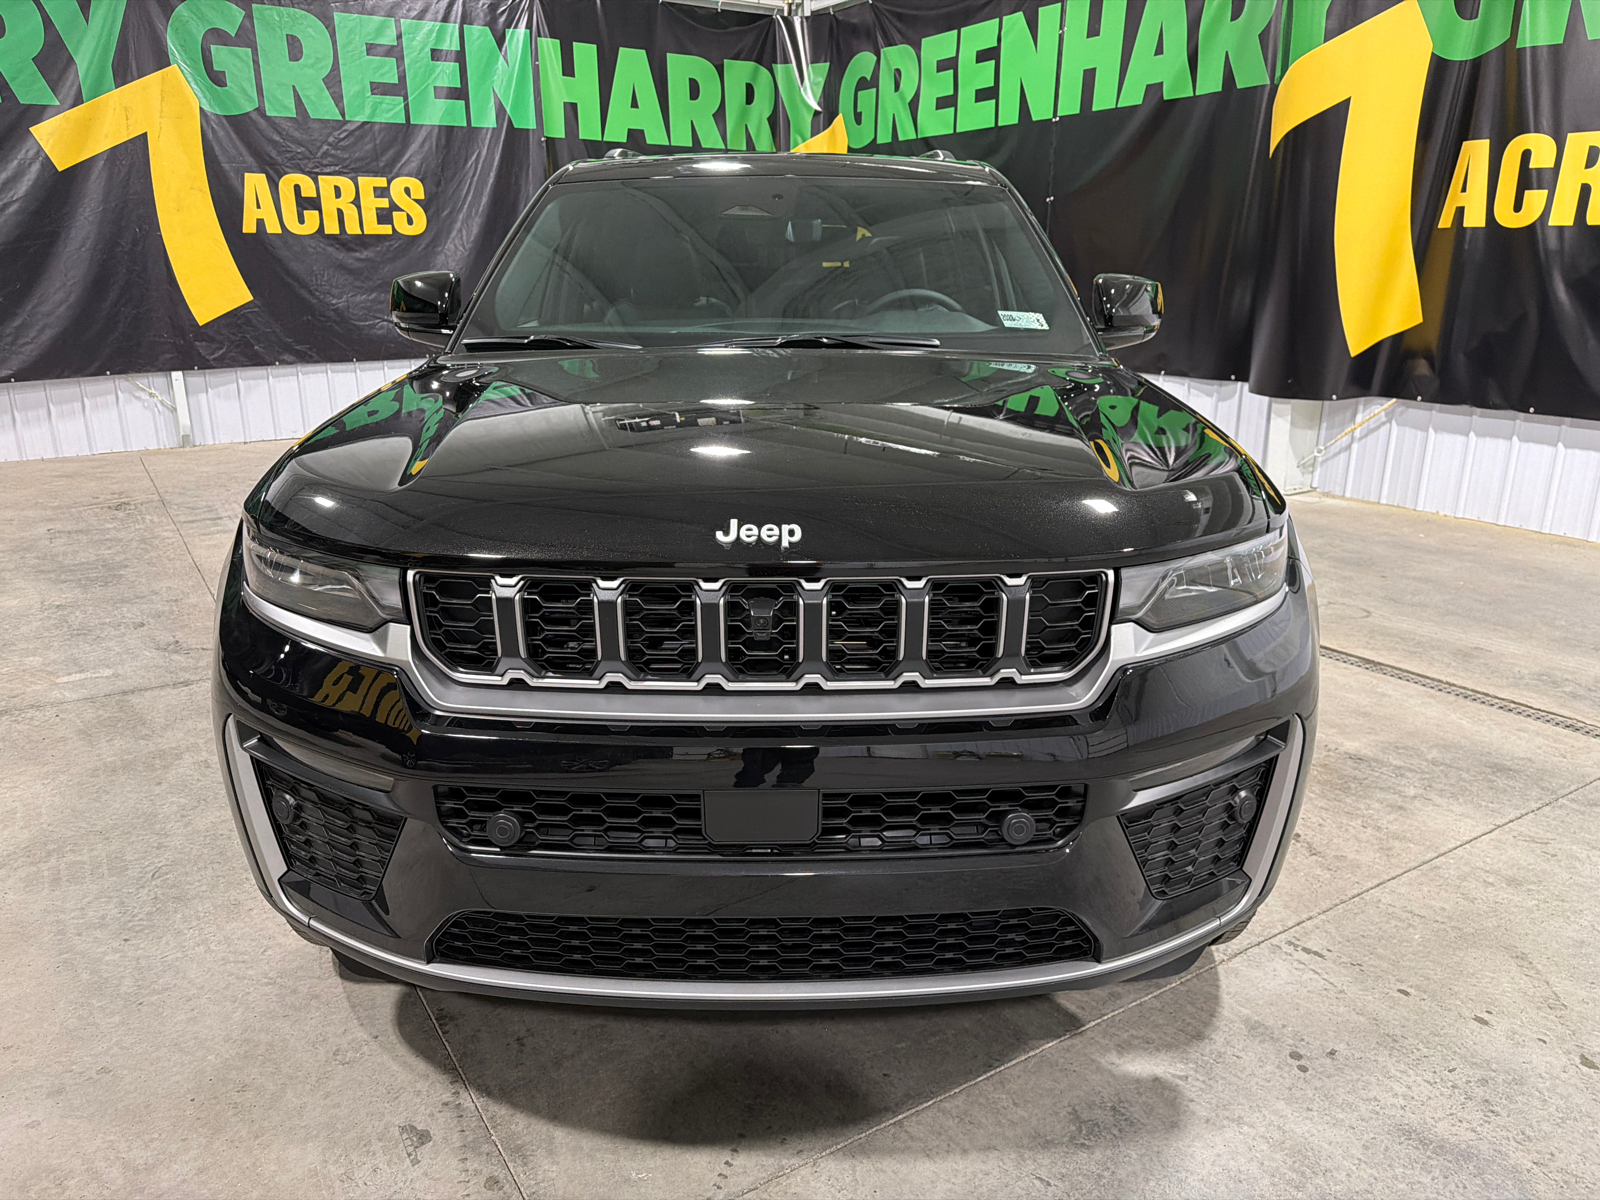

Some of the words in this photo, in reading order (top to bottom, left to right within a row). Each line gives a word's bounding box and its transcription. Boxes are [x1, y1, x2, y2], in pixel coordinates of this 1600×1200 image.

[167, 0, 536, 129] GREEN
[537, 37, 829, 153] HARRY
[838, 3, 1061, 150] GREEN
[29, 63, 254, 326] 7
[242, 172, 428, 236] ACRES
[1269, 0, 1433, 358] 7
[715, 518, 803, 549] Jeep
